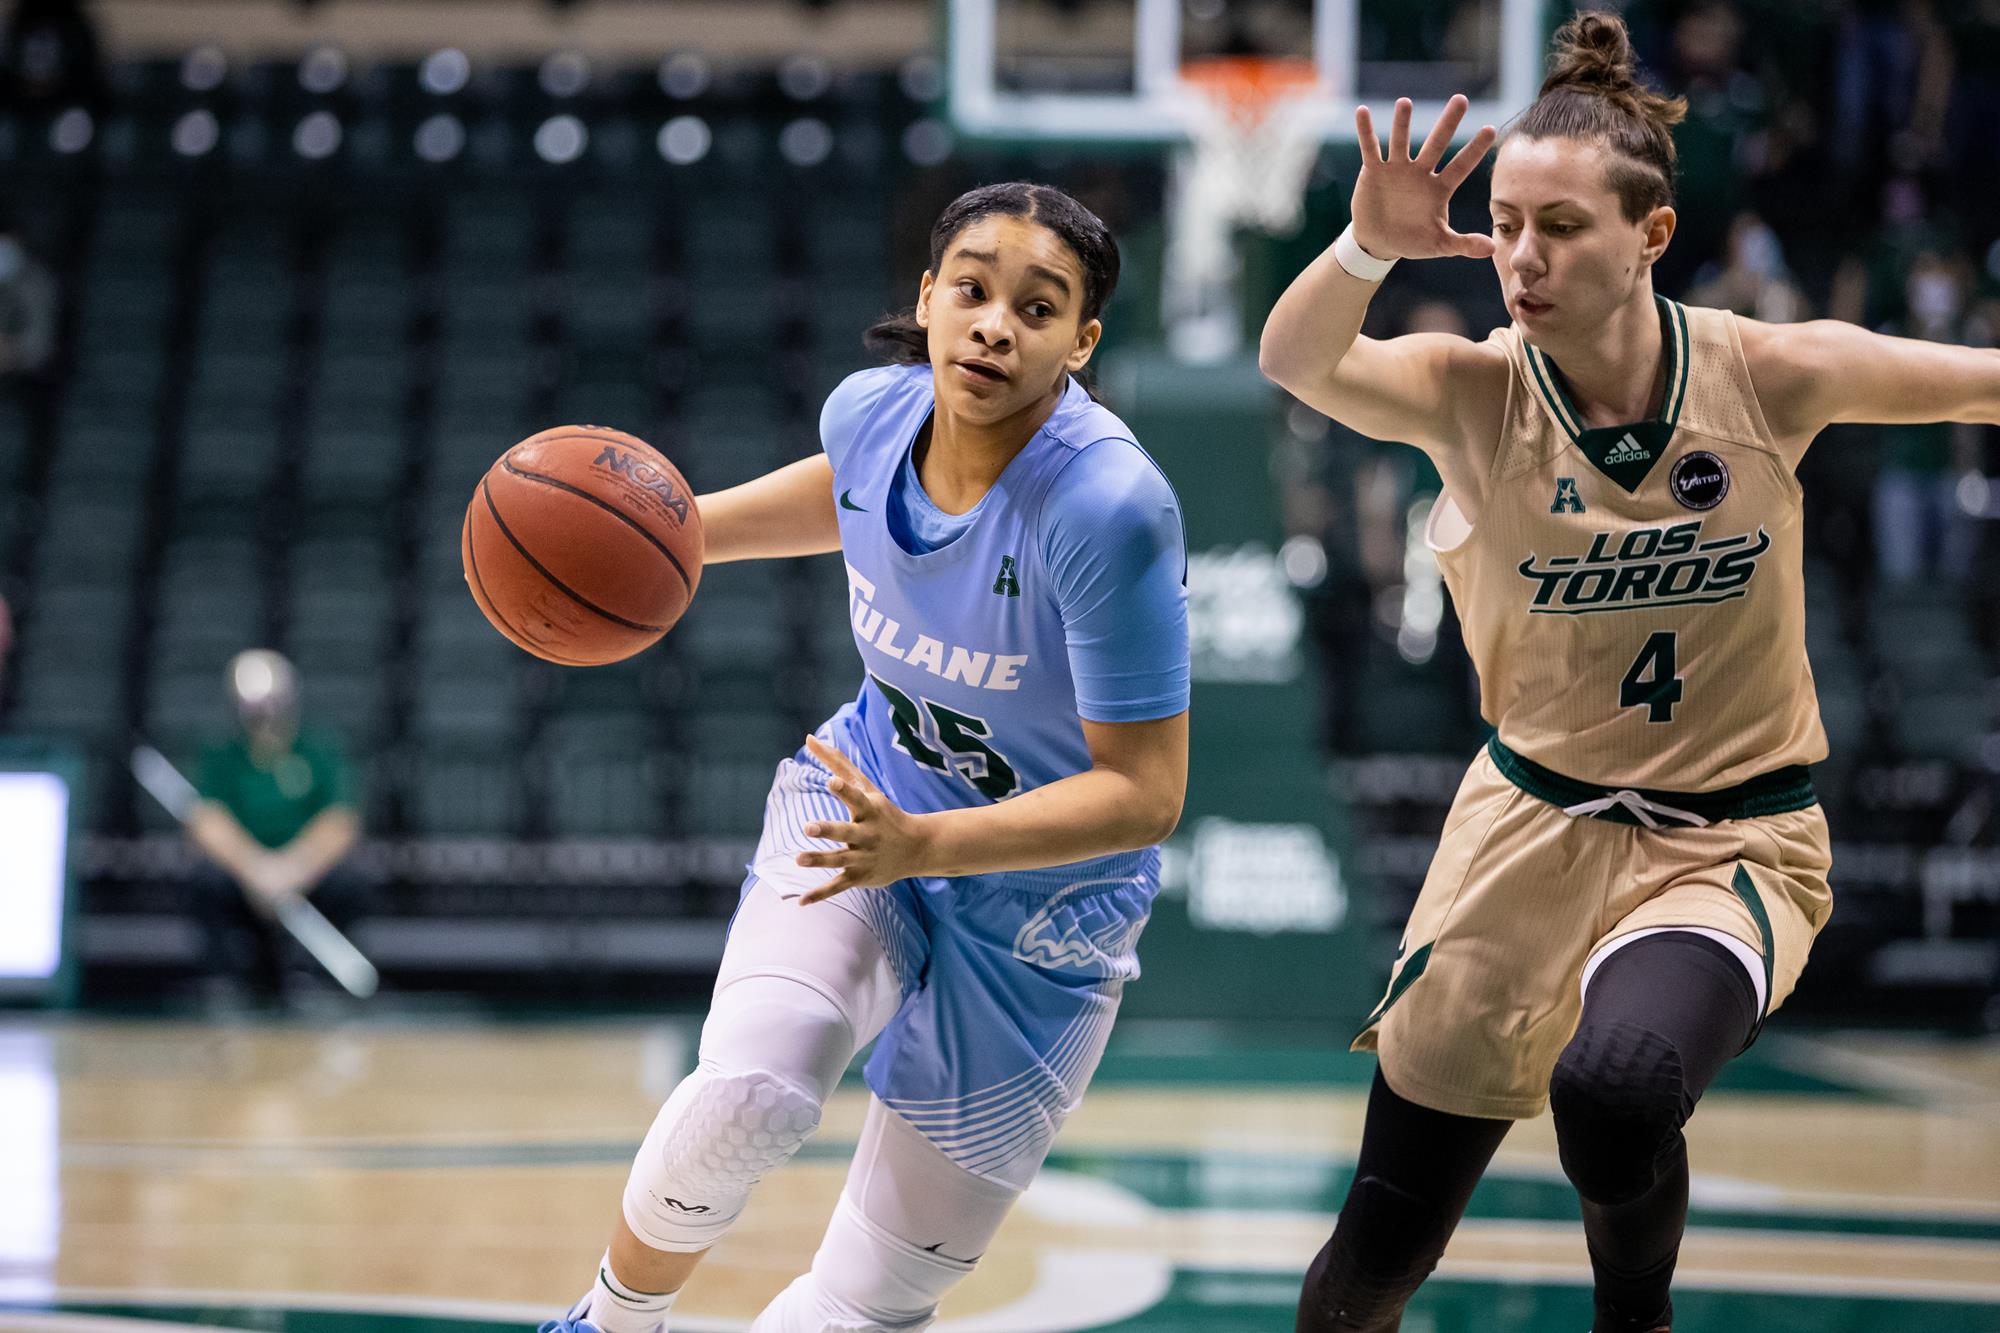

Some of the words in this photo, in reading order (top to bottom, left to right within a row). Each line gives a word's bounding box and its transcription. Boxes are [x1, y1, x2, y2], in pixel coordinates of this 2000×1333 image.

[592, 445, 689, 527] NCAA
[1604, 450, 1651, 465] adidas
[1551, 477, 1586, 514] A
[1518, 525, 1772, 606] TOROS
[1586, 520, 1703, 565] LOS
[992, 555, 1021, 597] A
[845, 560, 1029, 691] TULANE
[1619, 629, 1684, 724] 4
